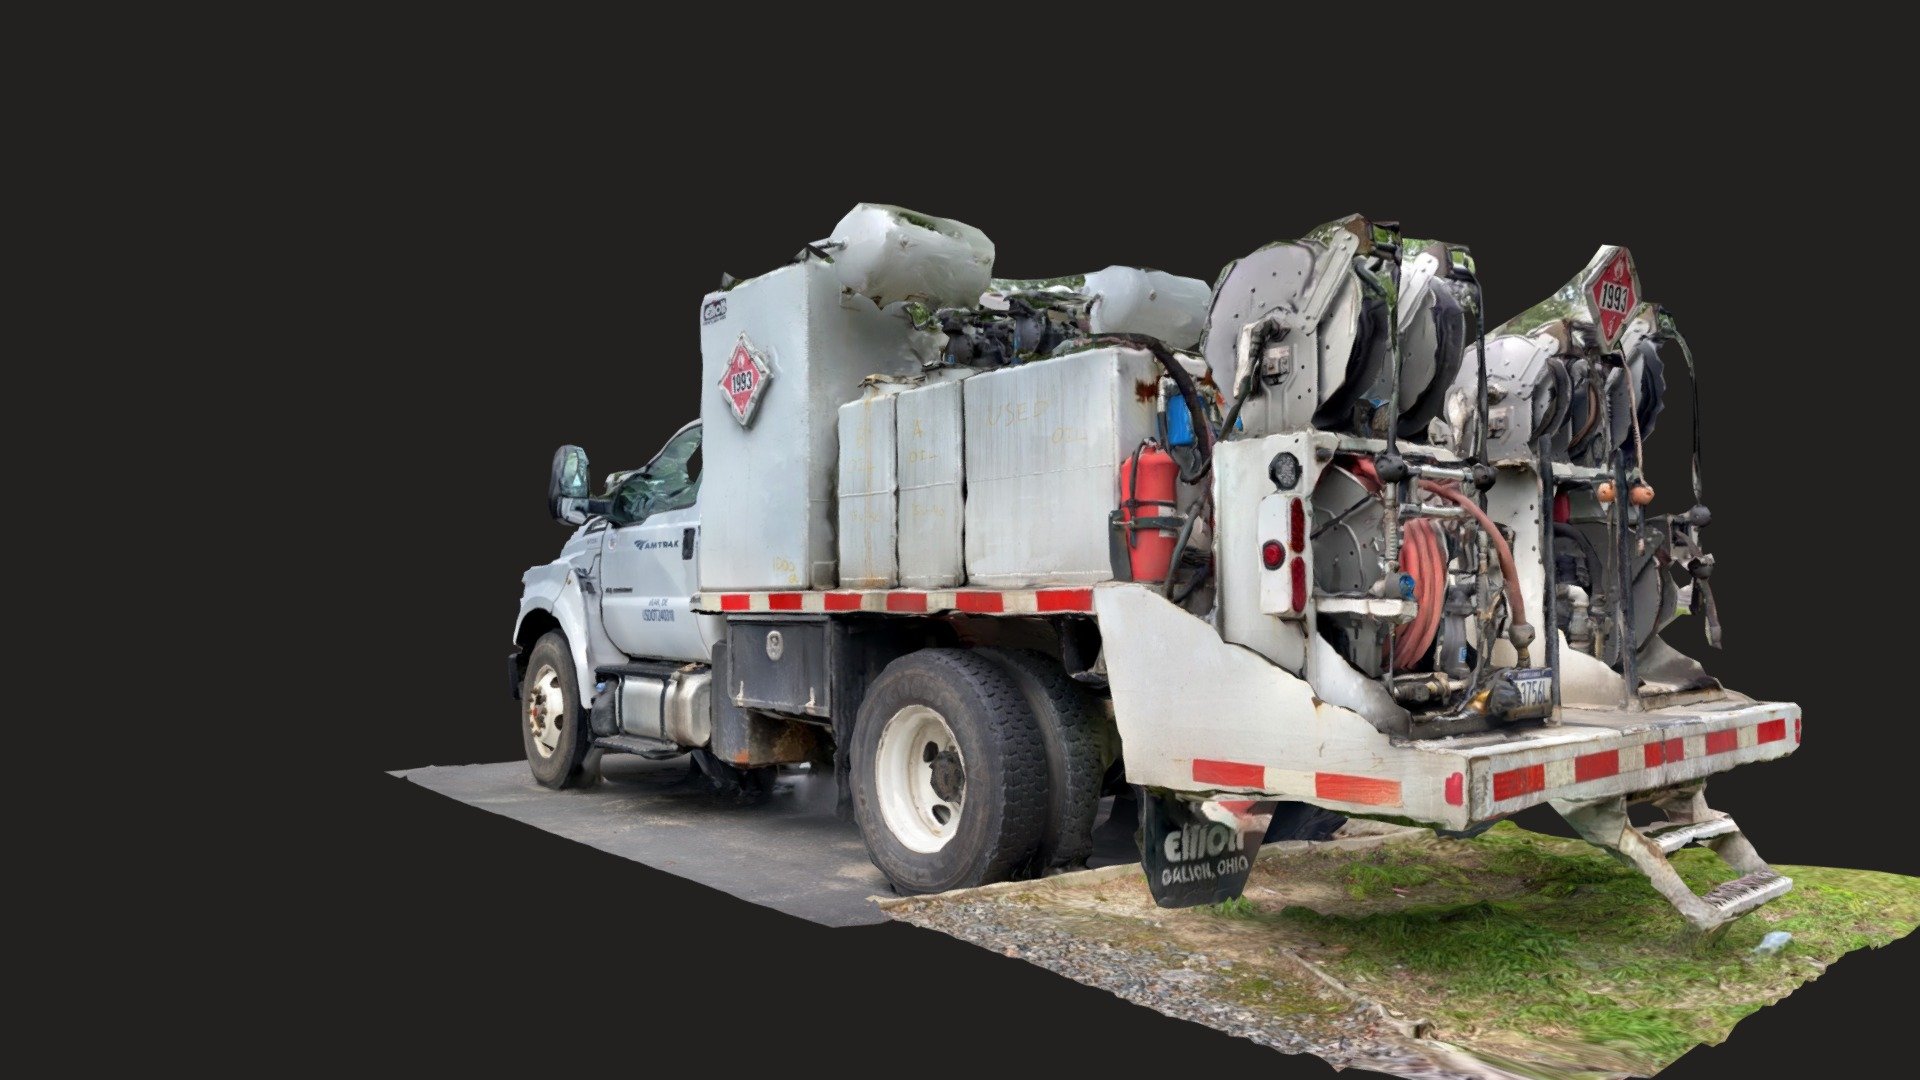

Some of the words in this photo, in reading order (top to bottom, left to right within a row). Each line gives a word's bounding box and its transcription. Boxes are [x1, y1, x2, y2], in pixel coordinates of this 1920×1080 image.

[1601, 283, 1628, 312] 1993
[732, 371, 753, 394] 1993
[986, 400, 1051, 428] USED
[644, 540, 679, 550] AMTRAK
[1217, 854, 1250, 876] OHIO
